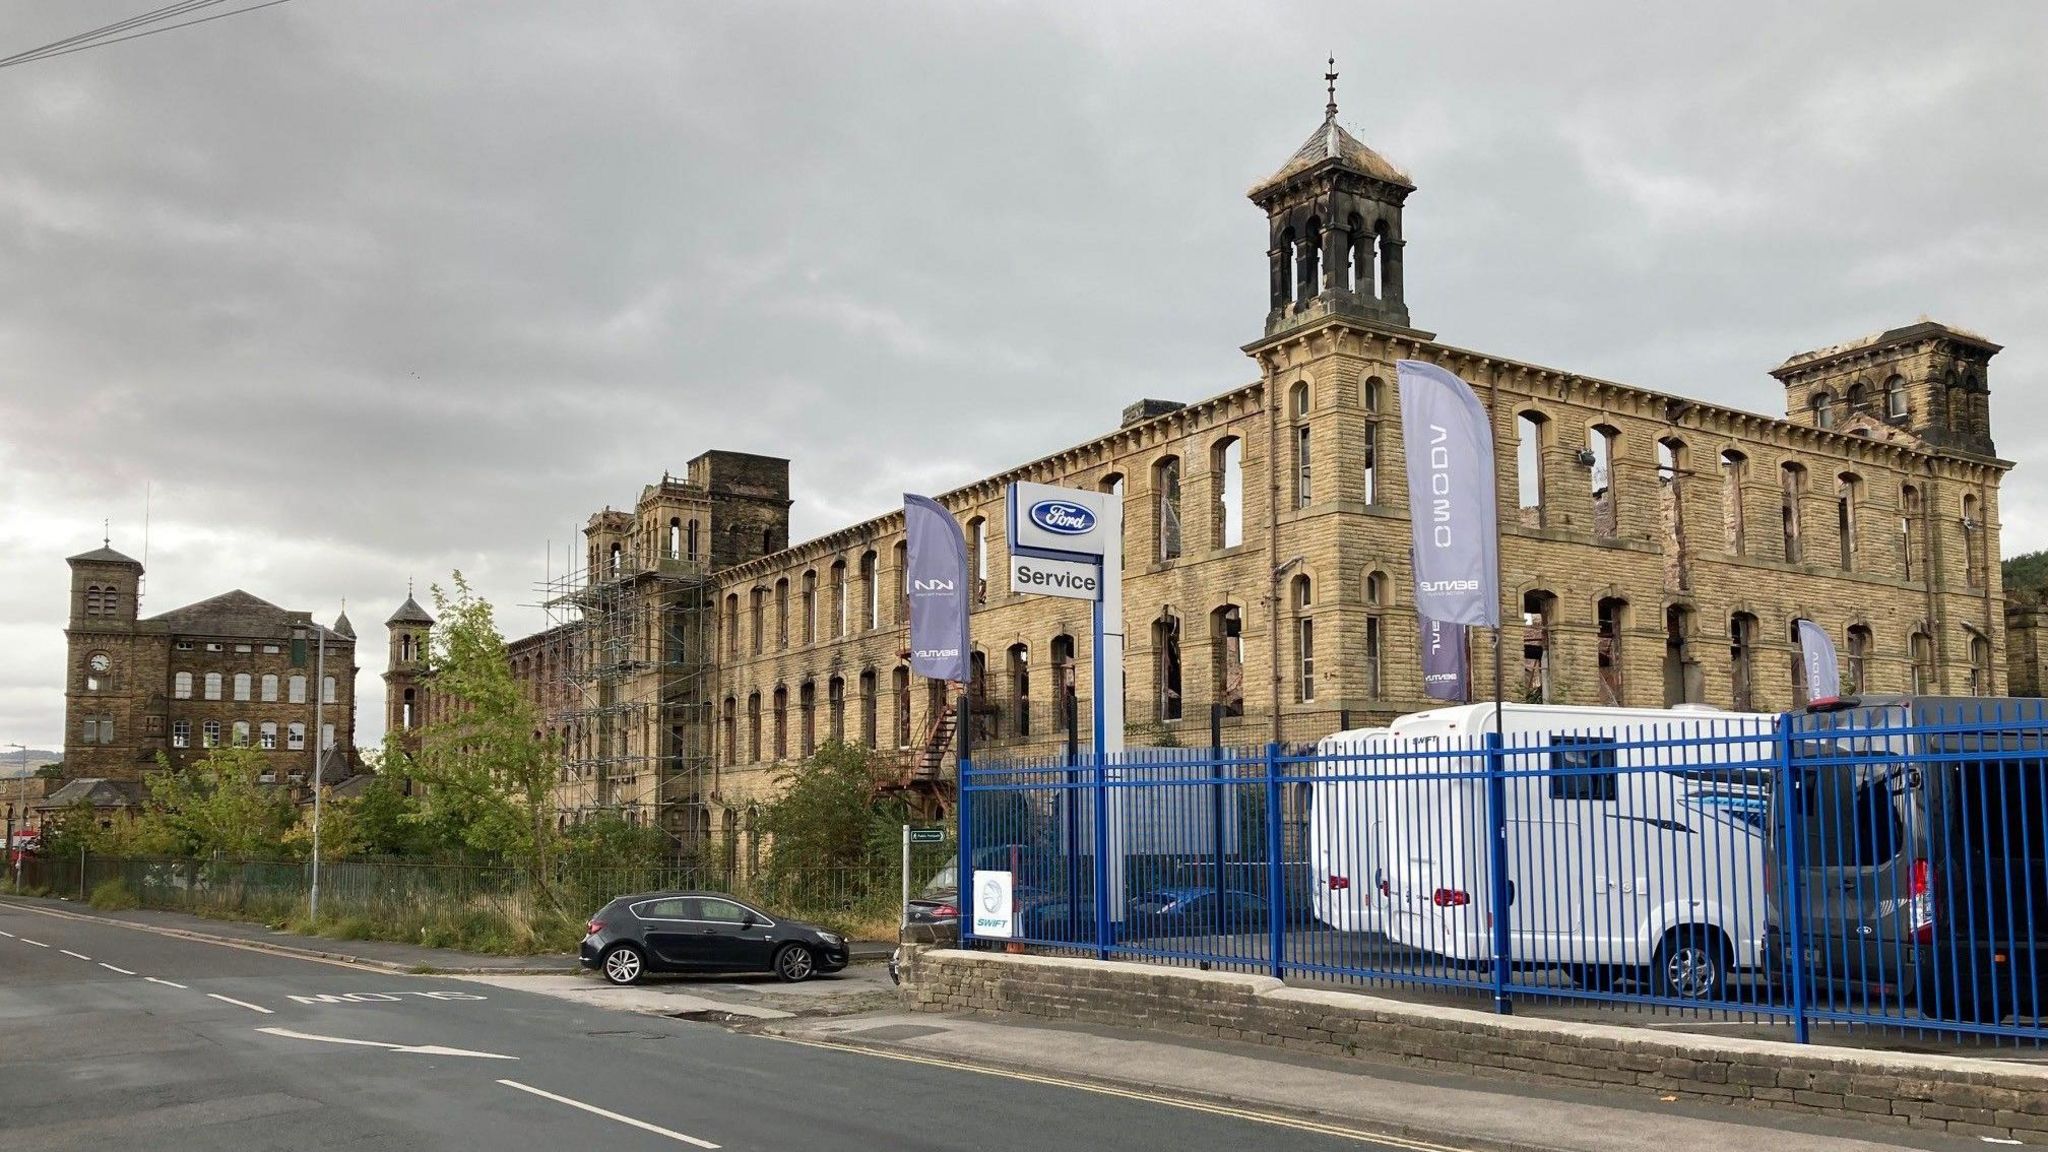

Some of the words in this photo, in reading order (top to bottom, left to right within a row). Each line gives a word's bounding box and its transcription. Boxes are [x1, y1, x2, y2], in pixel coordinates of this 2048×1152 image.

[1045, 505, 1086, 529] Ford
[1017, 565, 1097, 591] Service
[977, 918, 1008, 929] SWIFT
